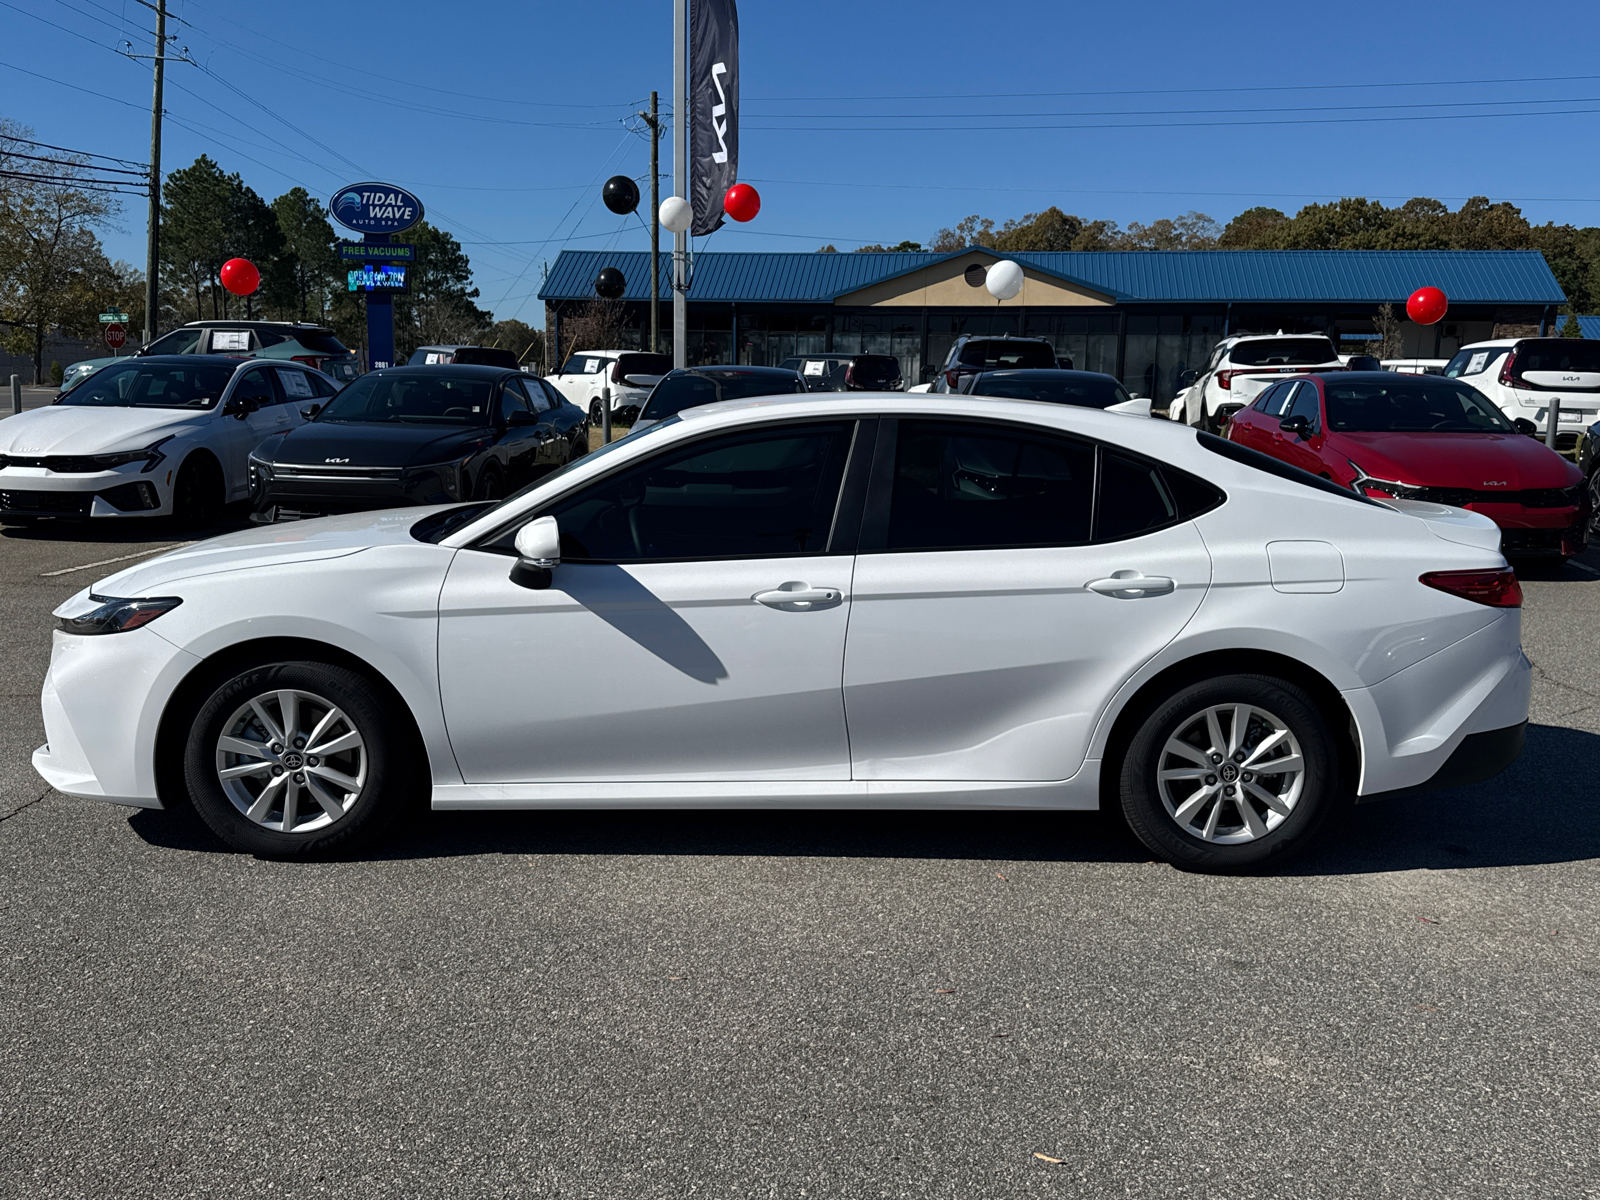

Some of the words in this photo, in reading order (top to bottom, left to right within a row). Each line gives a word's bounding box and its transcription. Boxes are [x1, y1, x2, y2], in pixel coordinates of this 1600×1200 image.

[711, 61, 728, 164] KIA
[362, 192, 403, 206] TIDAL
[369, 206, 412, 219] WAVE
[343, 246, 366, 255] FREE
[368, 247, 410, 256] VACUUMS
[107, 331, 125, 341] STOP
[199, 673, 260, 738] ASSURANCE
